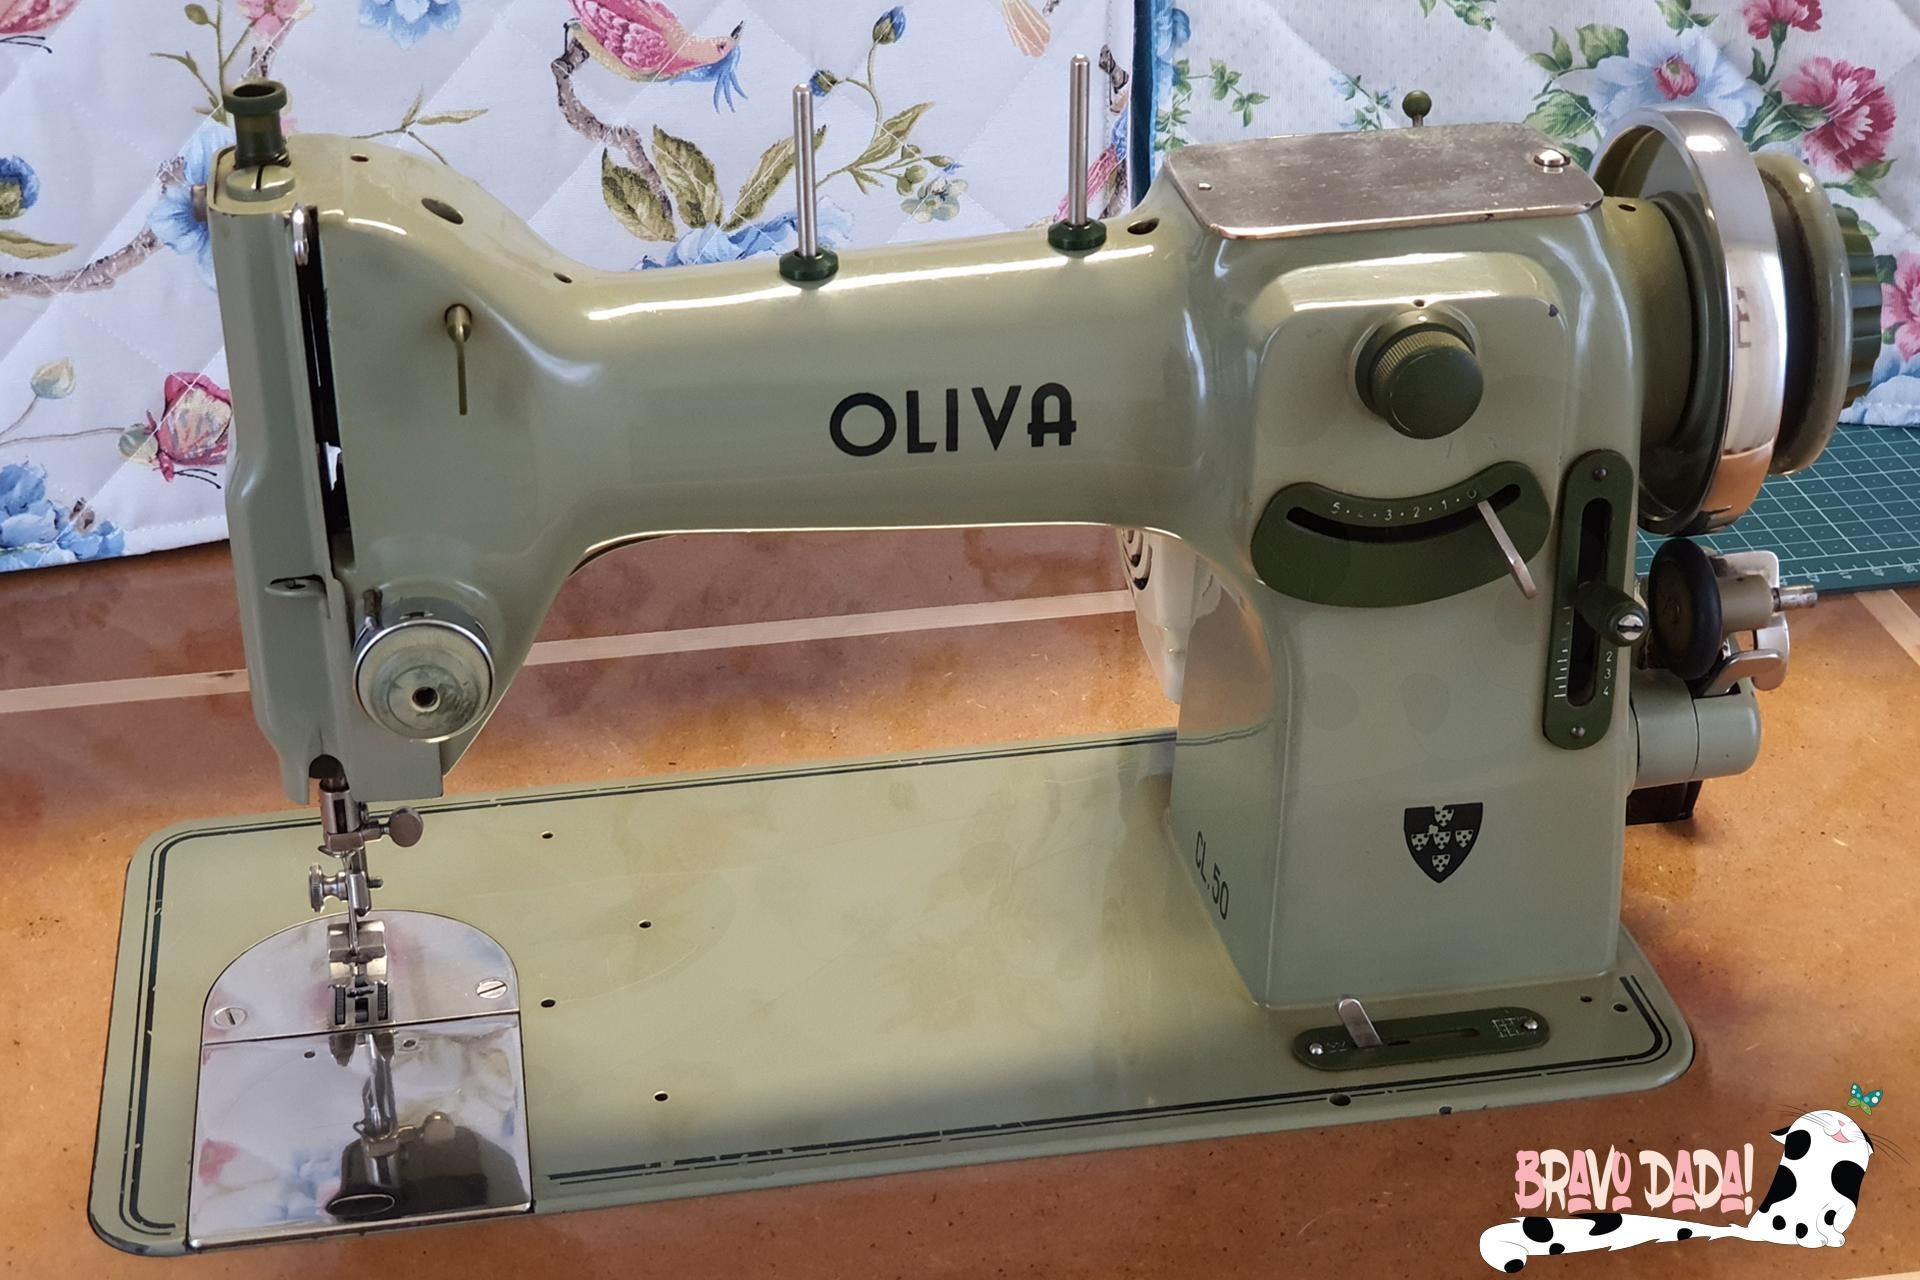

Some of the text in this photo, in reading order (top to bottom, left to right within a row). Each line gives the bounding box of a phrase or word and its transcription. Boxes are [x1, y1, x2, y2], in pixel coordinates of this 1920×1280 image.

[829, 382, 1077, 457] OLIVA
[1331, 502, 1341, 514] 5
[1384, 509, 1393, 521] 3
[1413, 506, 1421, 518] 2
[1606, 651, 1613, 662] 2
[1604, 668, 1611, 680] 3
